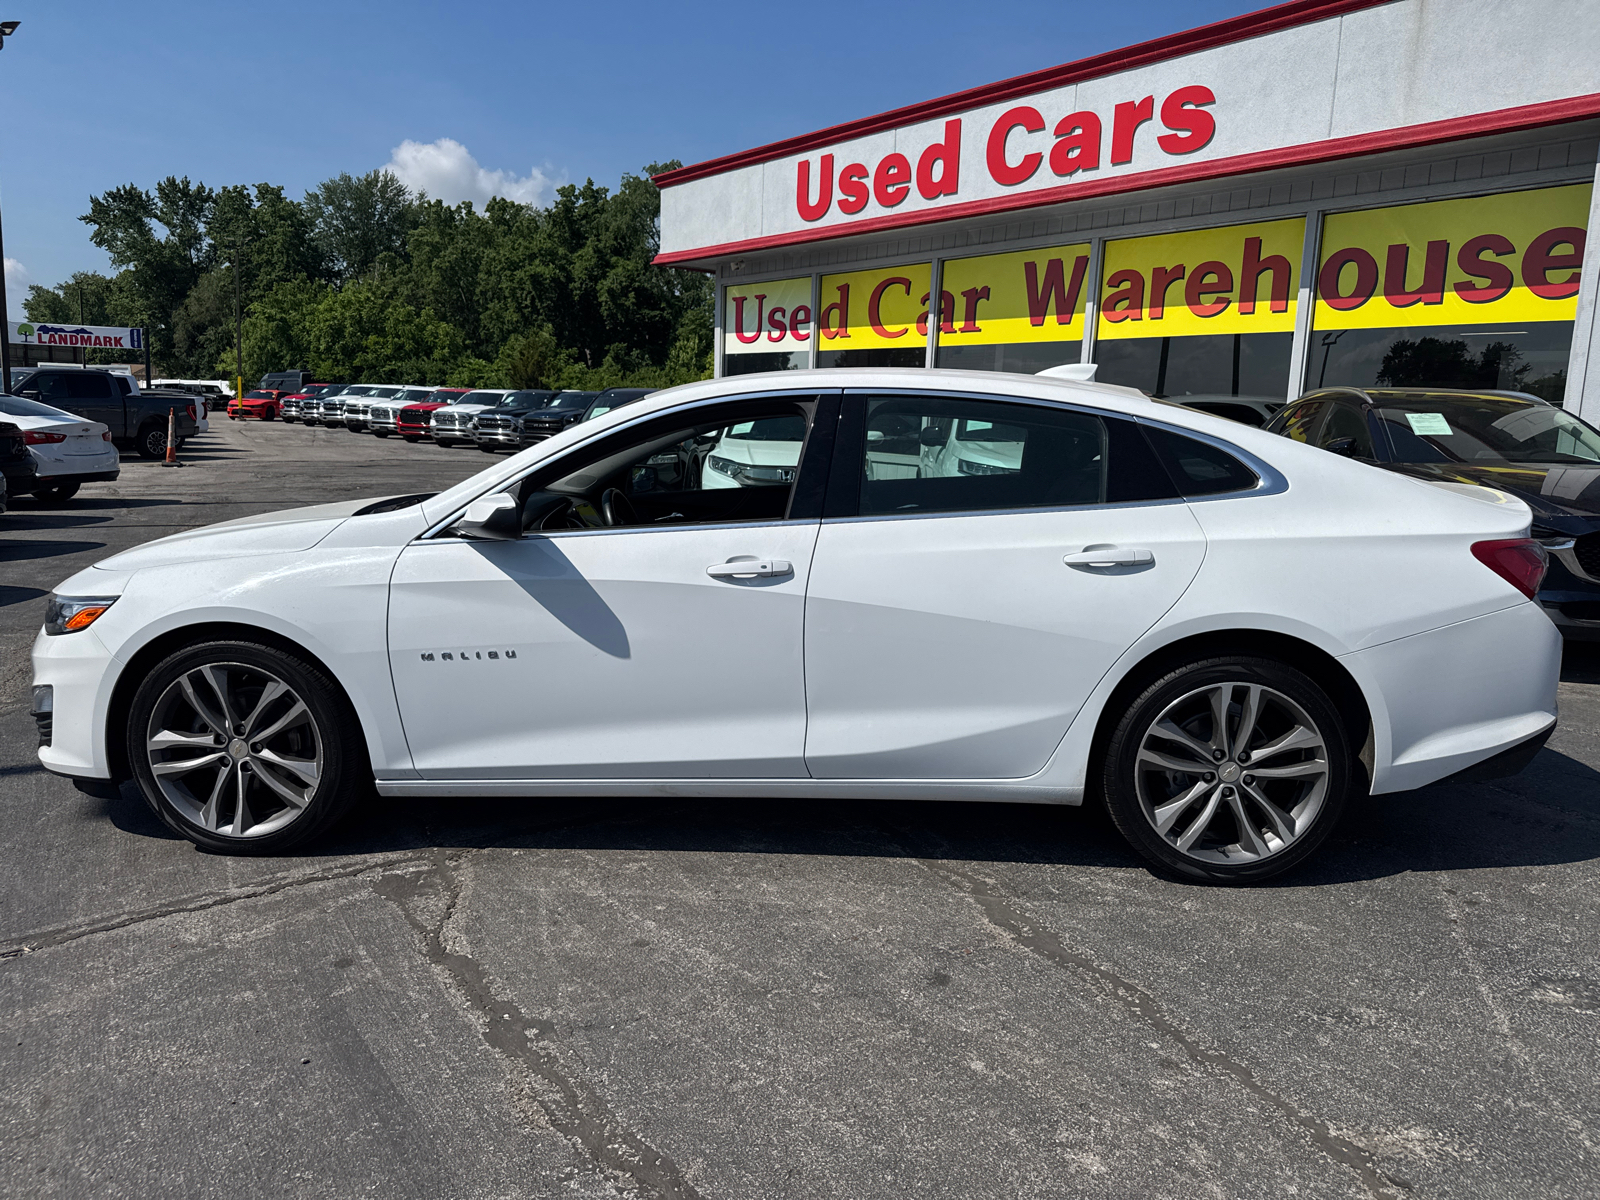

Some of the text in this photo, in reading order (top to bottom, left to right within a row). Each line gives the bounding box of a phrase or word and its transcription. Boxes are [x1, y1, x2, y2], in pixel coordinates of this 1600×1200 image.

[796, 85, 1216, 222] Used Cars
[732, 226, 1587, 344] Used Car Warehouse
[37, 333, 124, 348] LANDMARK
[420, 650, 517, 661] MALIBU
